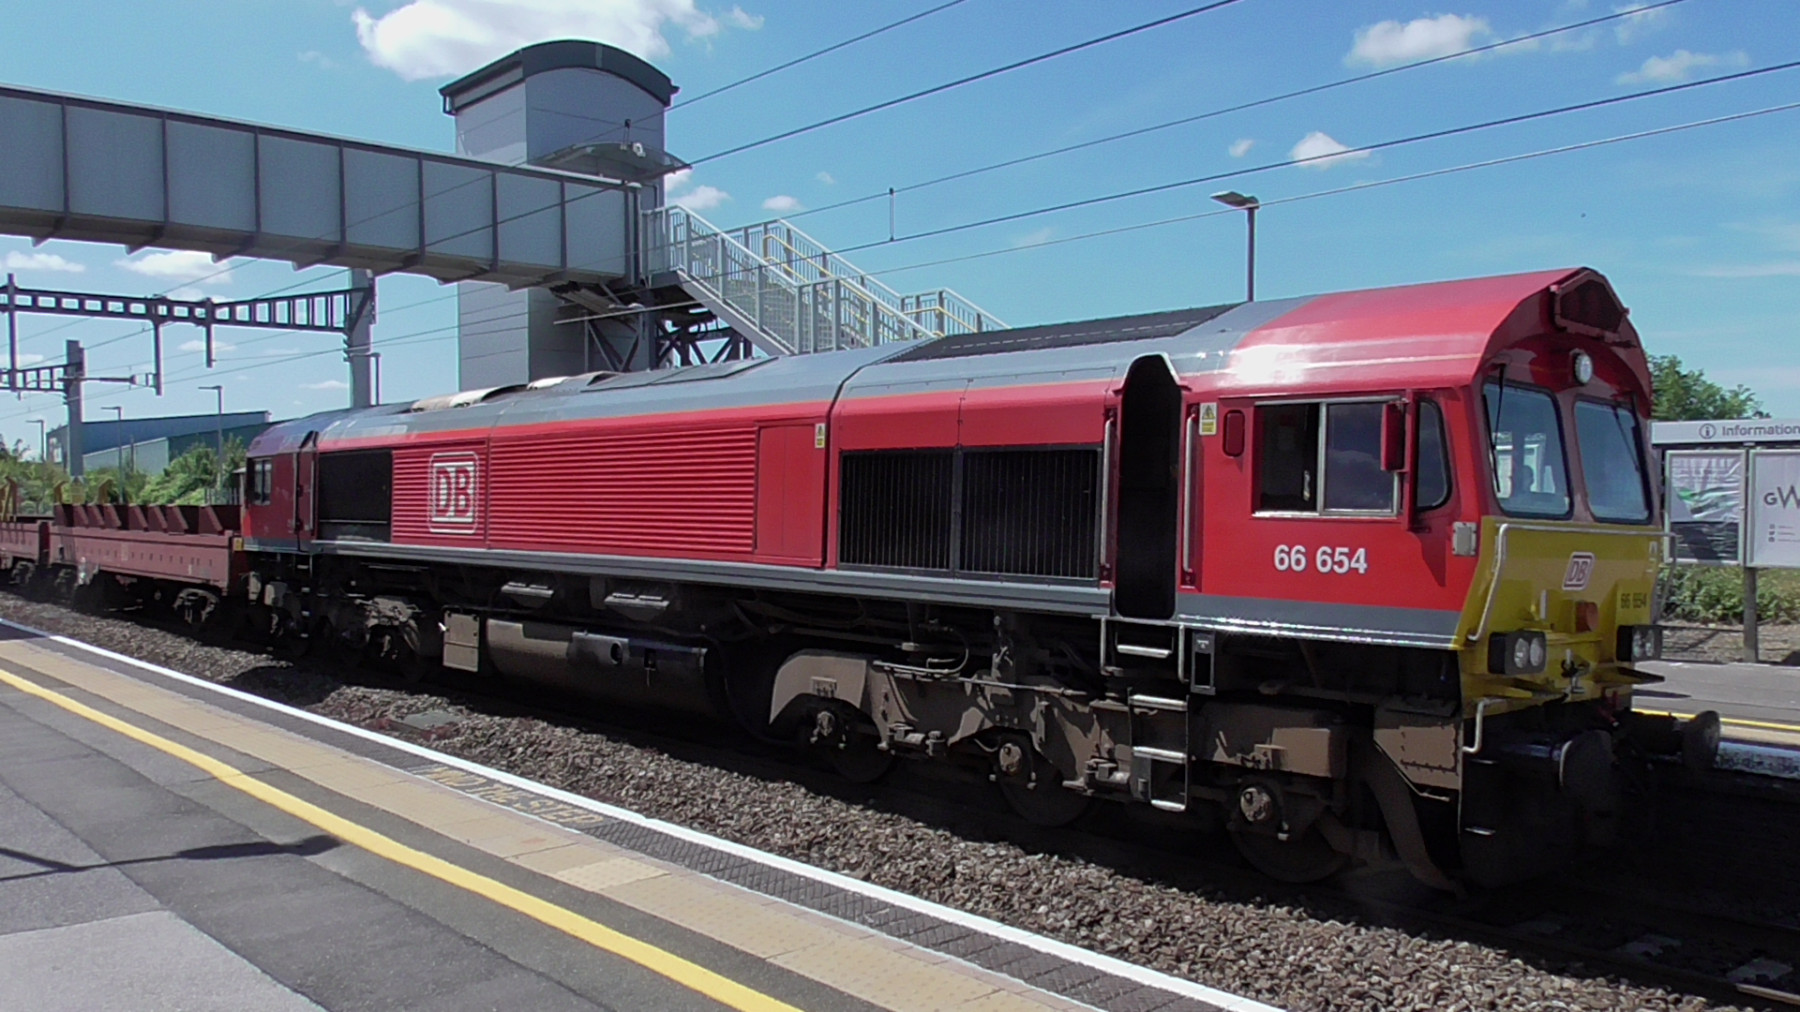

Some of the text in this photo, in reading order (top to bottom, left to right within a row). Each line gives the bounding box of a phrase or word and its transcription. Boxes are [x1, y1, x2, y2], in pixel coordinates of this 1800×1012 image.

[1721, 424, 1800, 437] Information
[432, 463, 475, 521] DB
[1274, 544, 1368, 574] 66 654
[1566, 557, 1589, 585] DB
[512, 799, 604, 823] STEP
